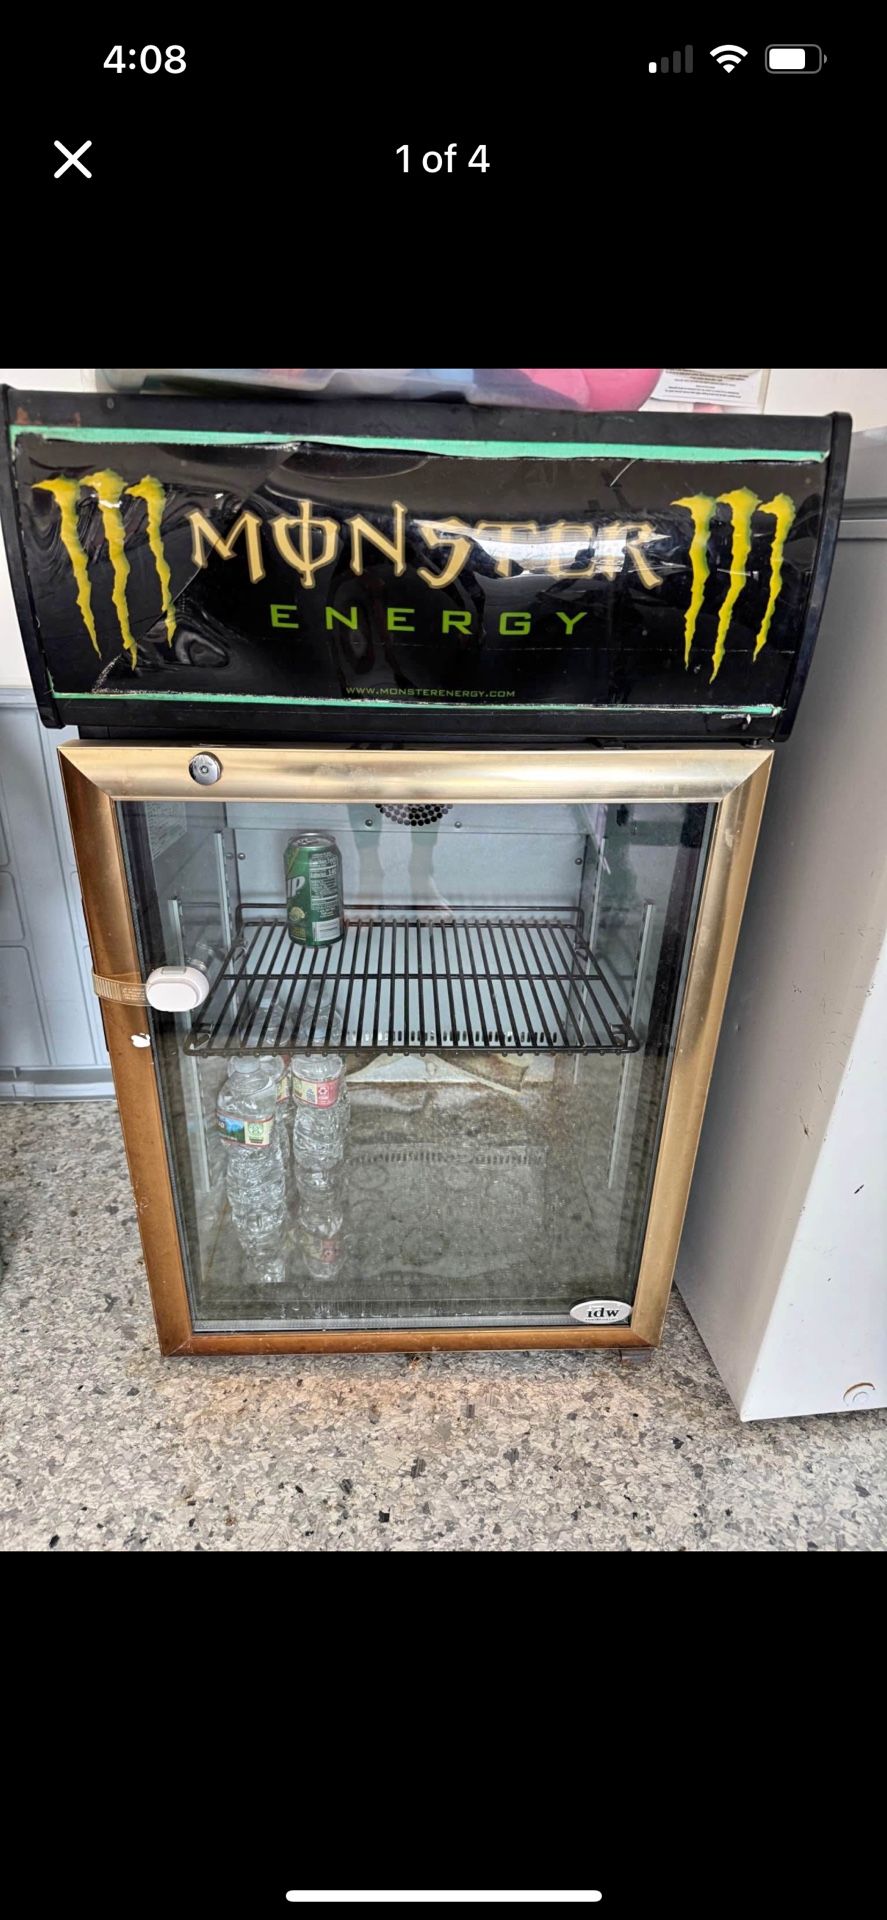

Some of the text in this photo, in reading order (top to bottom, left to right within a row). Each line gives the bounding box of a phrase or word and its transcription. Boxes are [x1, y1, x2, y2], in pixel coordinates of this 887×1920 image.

[270, 603, 588, 635] ENERGY
[345, 687, 516, 698] WWW.MONSTERENERGY.COM
[587, 1307, 620, 1318] idw
